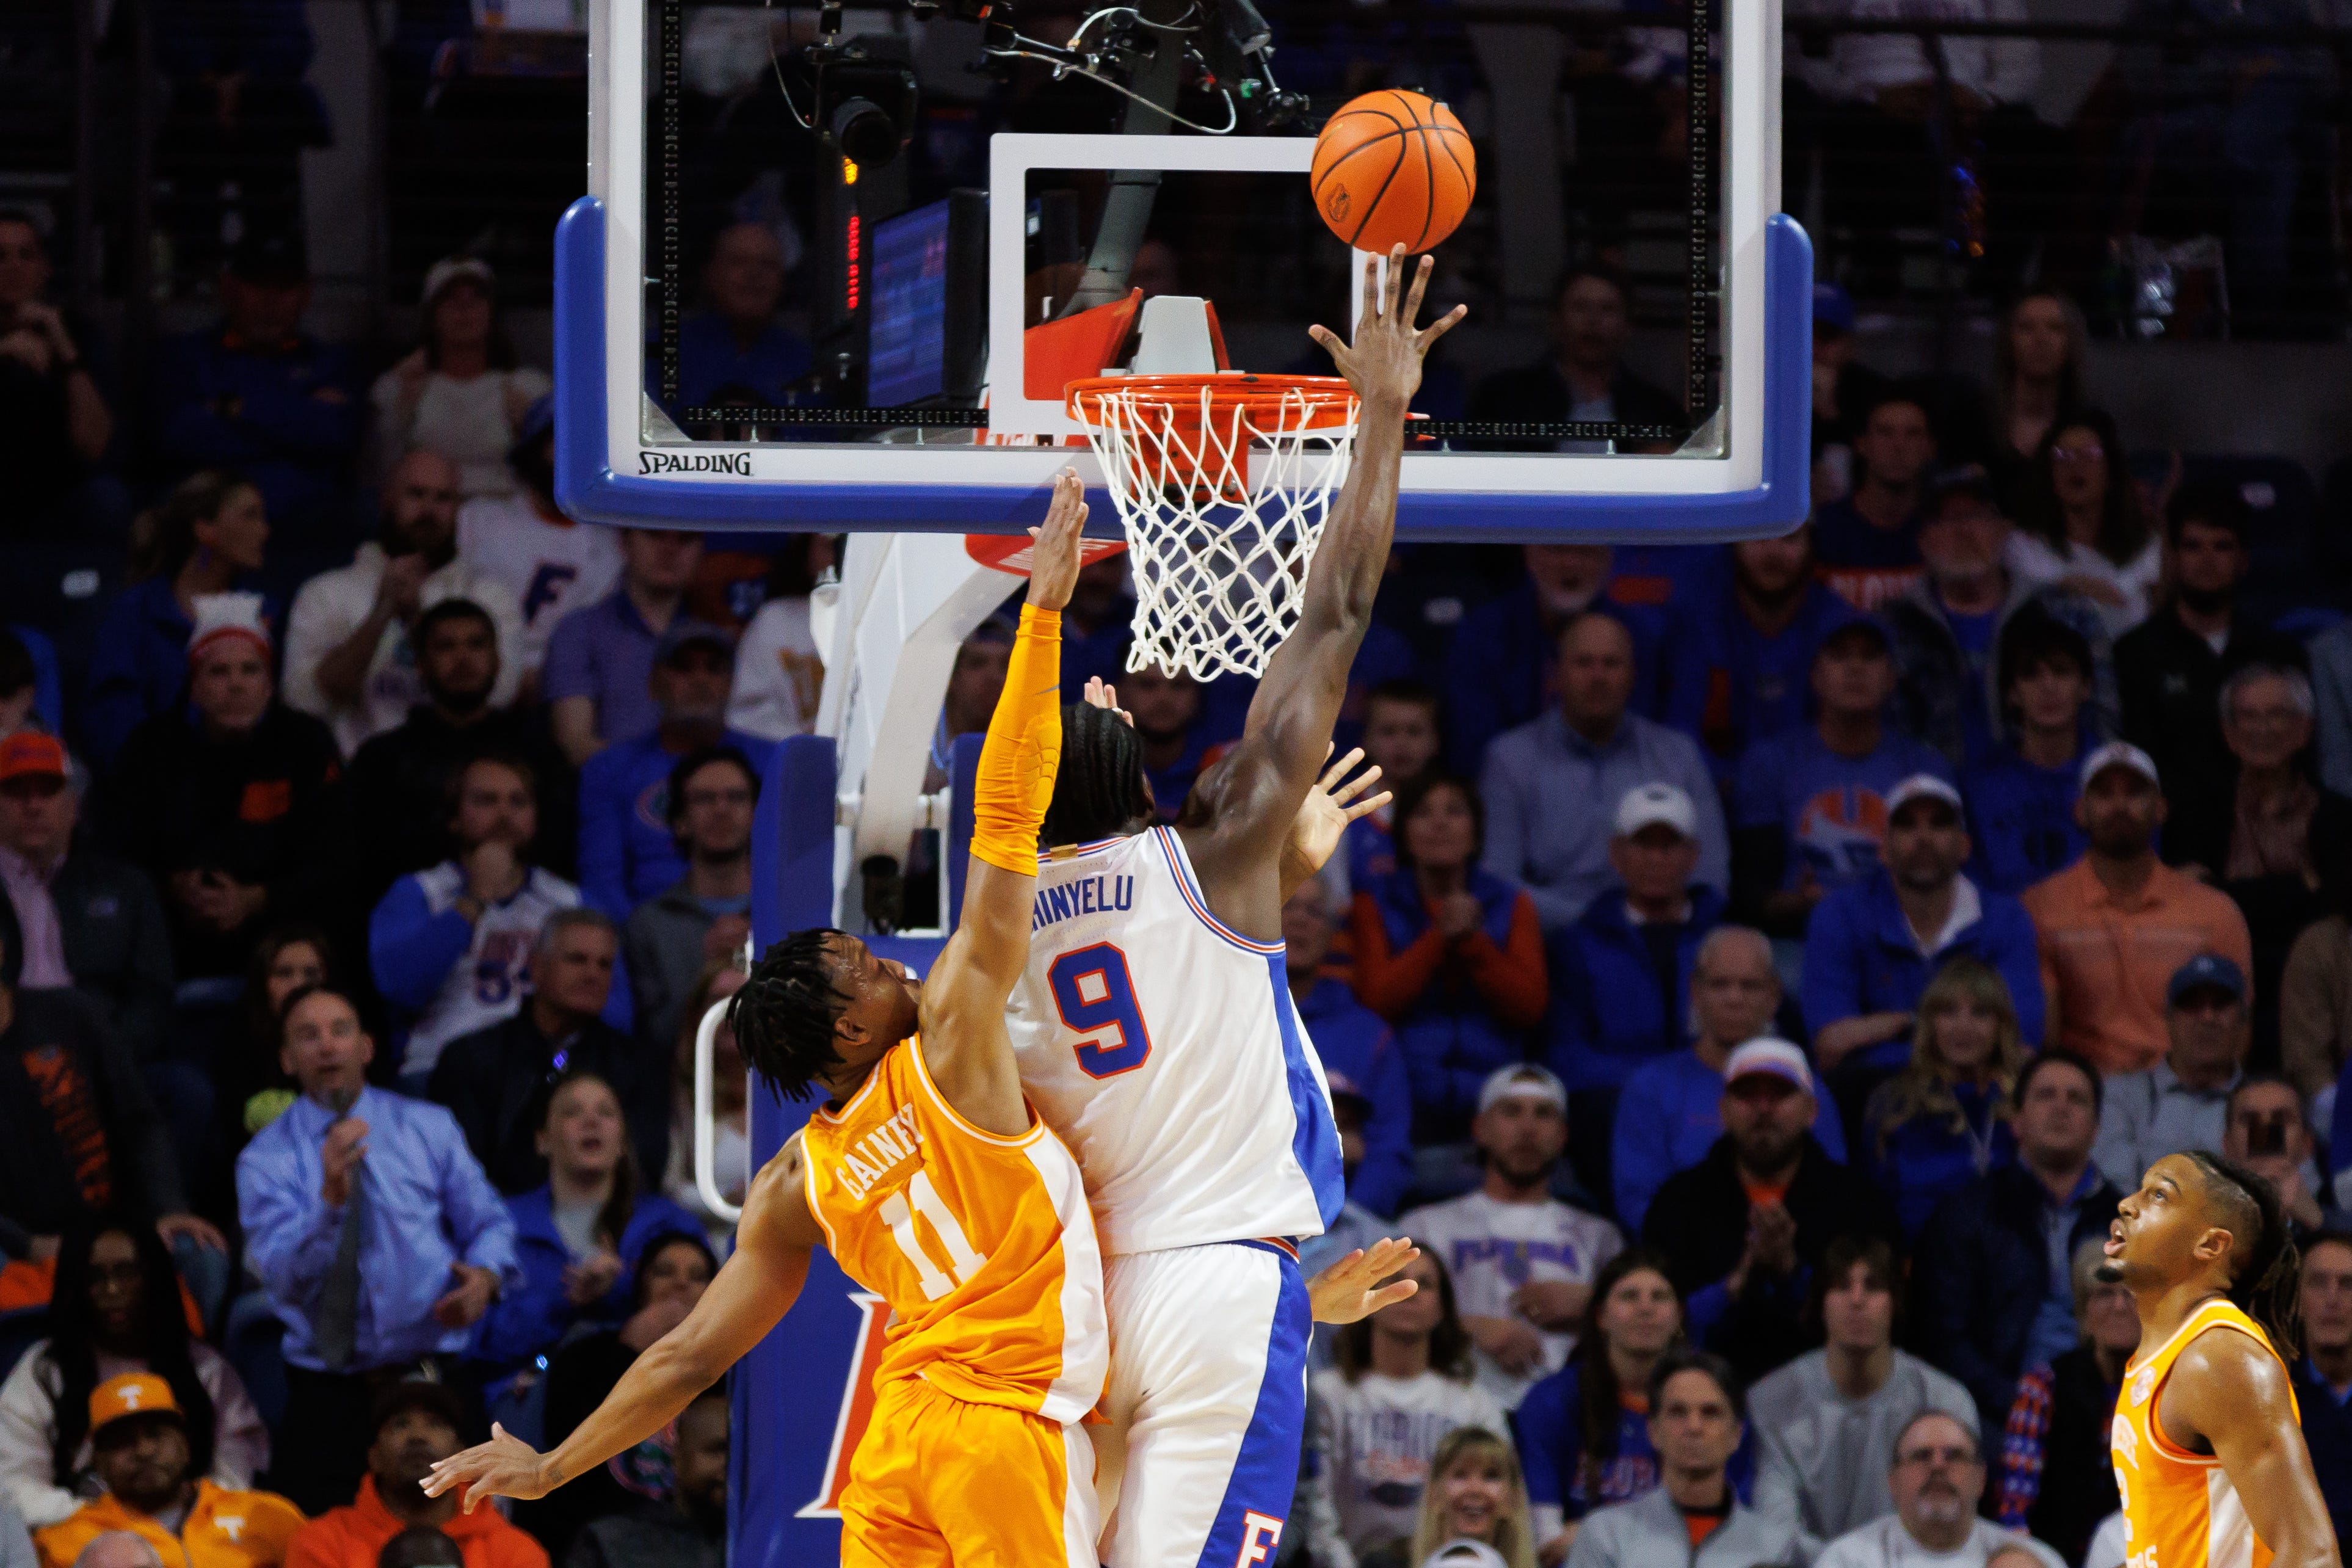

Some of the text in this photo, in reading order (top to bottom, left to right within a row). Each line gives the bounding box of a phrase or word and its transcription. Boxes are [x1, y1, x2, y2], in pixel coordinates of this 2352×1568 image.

[639, 451, 751, 476] SPALDING
[1047, 940, 1152, 1081] 9
[835, 1102, 924, 1201] GAINEY
[878, 1169, 988, 1302] 11
[1235, 1508, 1285, 1568] F
